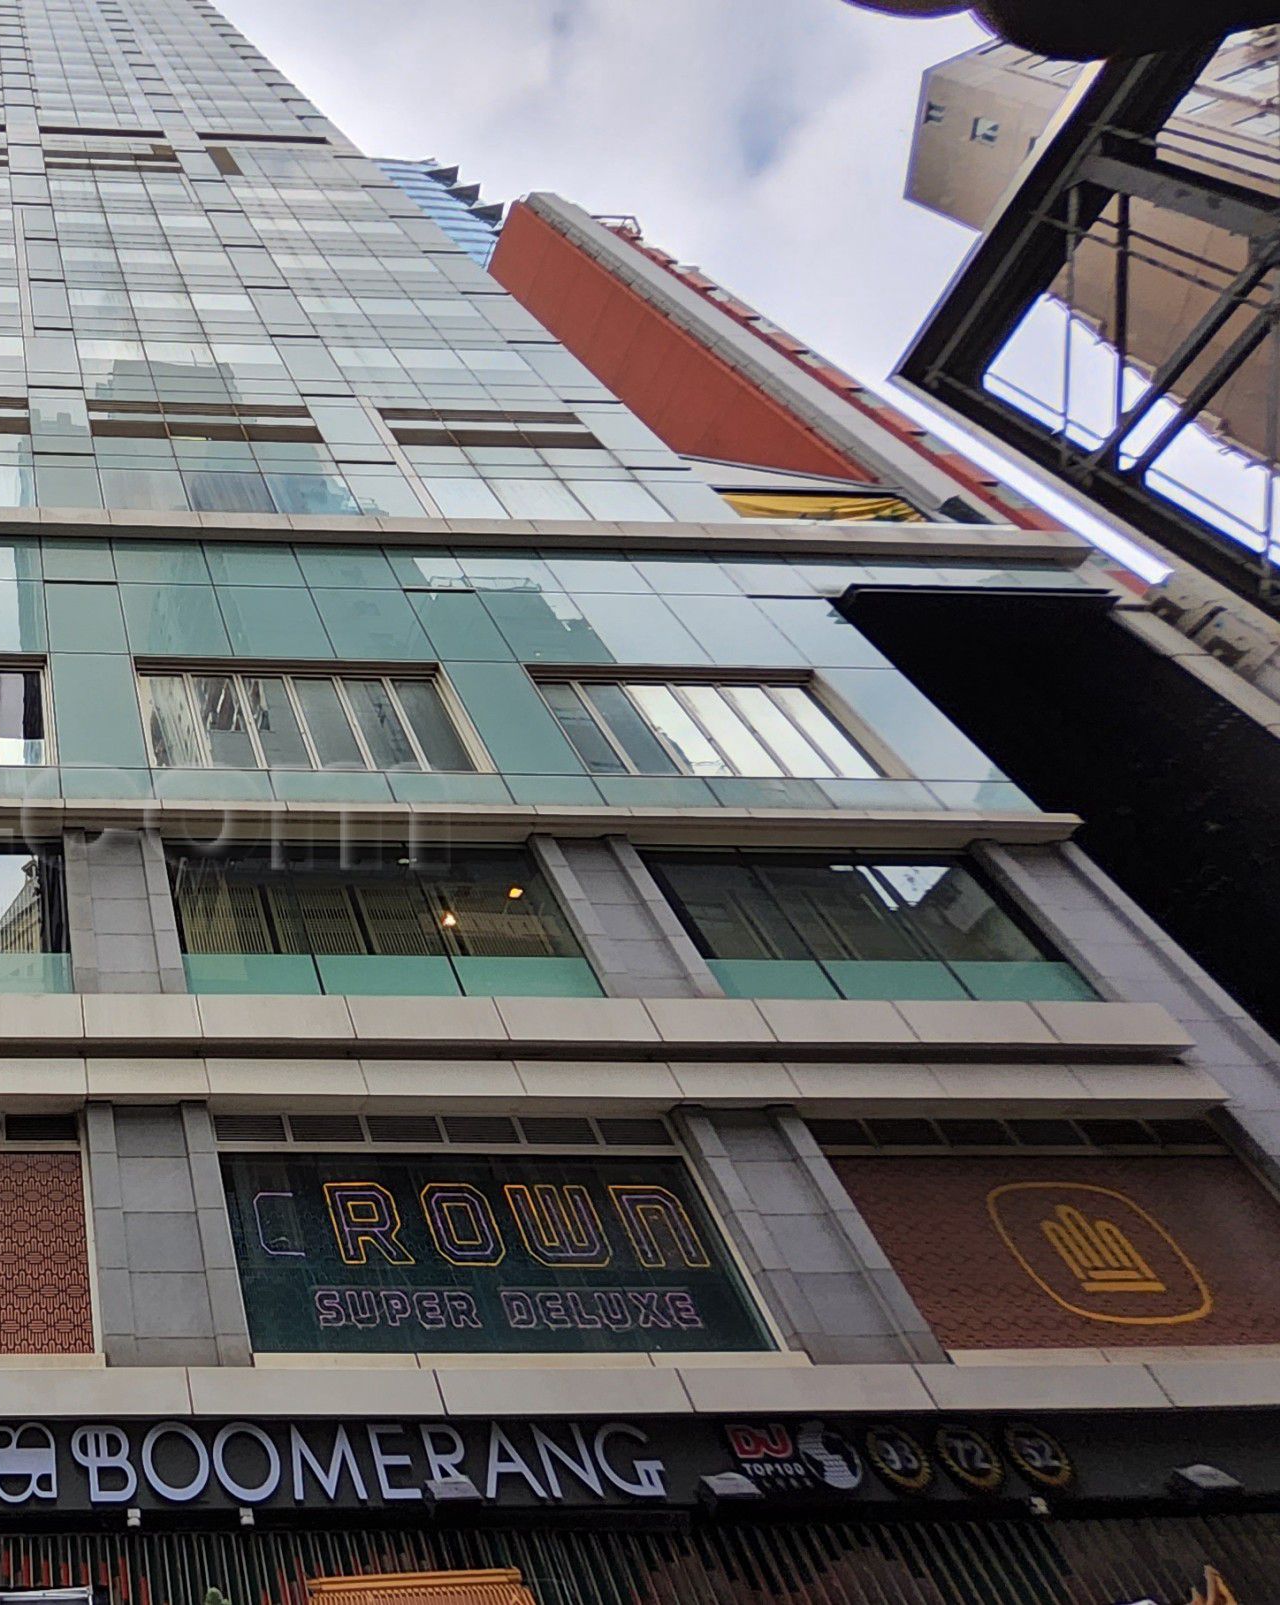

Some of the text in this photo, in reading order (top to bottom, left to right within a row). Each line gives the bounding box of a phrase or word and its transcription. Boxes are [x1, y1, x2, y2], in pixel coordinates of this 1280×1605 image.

[314, 1291, 703, 1331] SUPER DELUXE
[724, 1423, 793, 1458] DJ
[945, 1437, 992, 1470] 72
[71, 1421, 666, 1502] BOOMERANG
